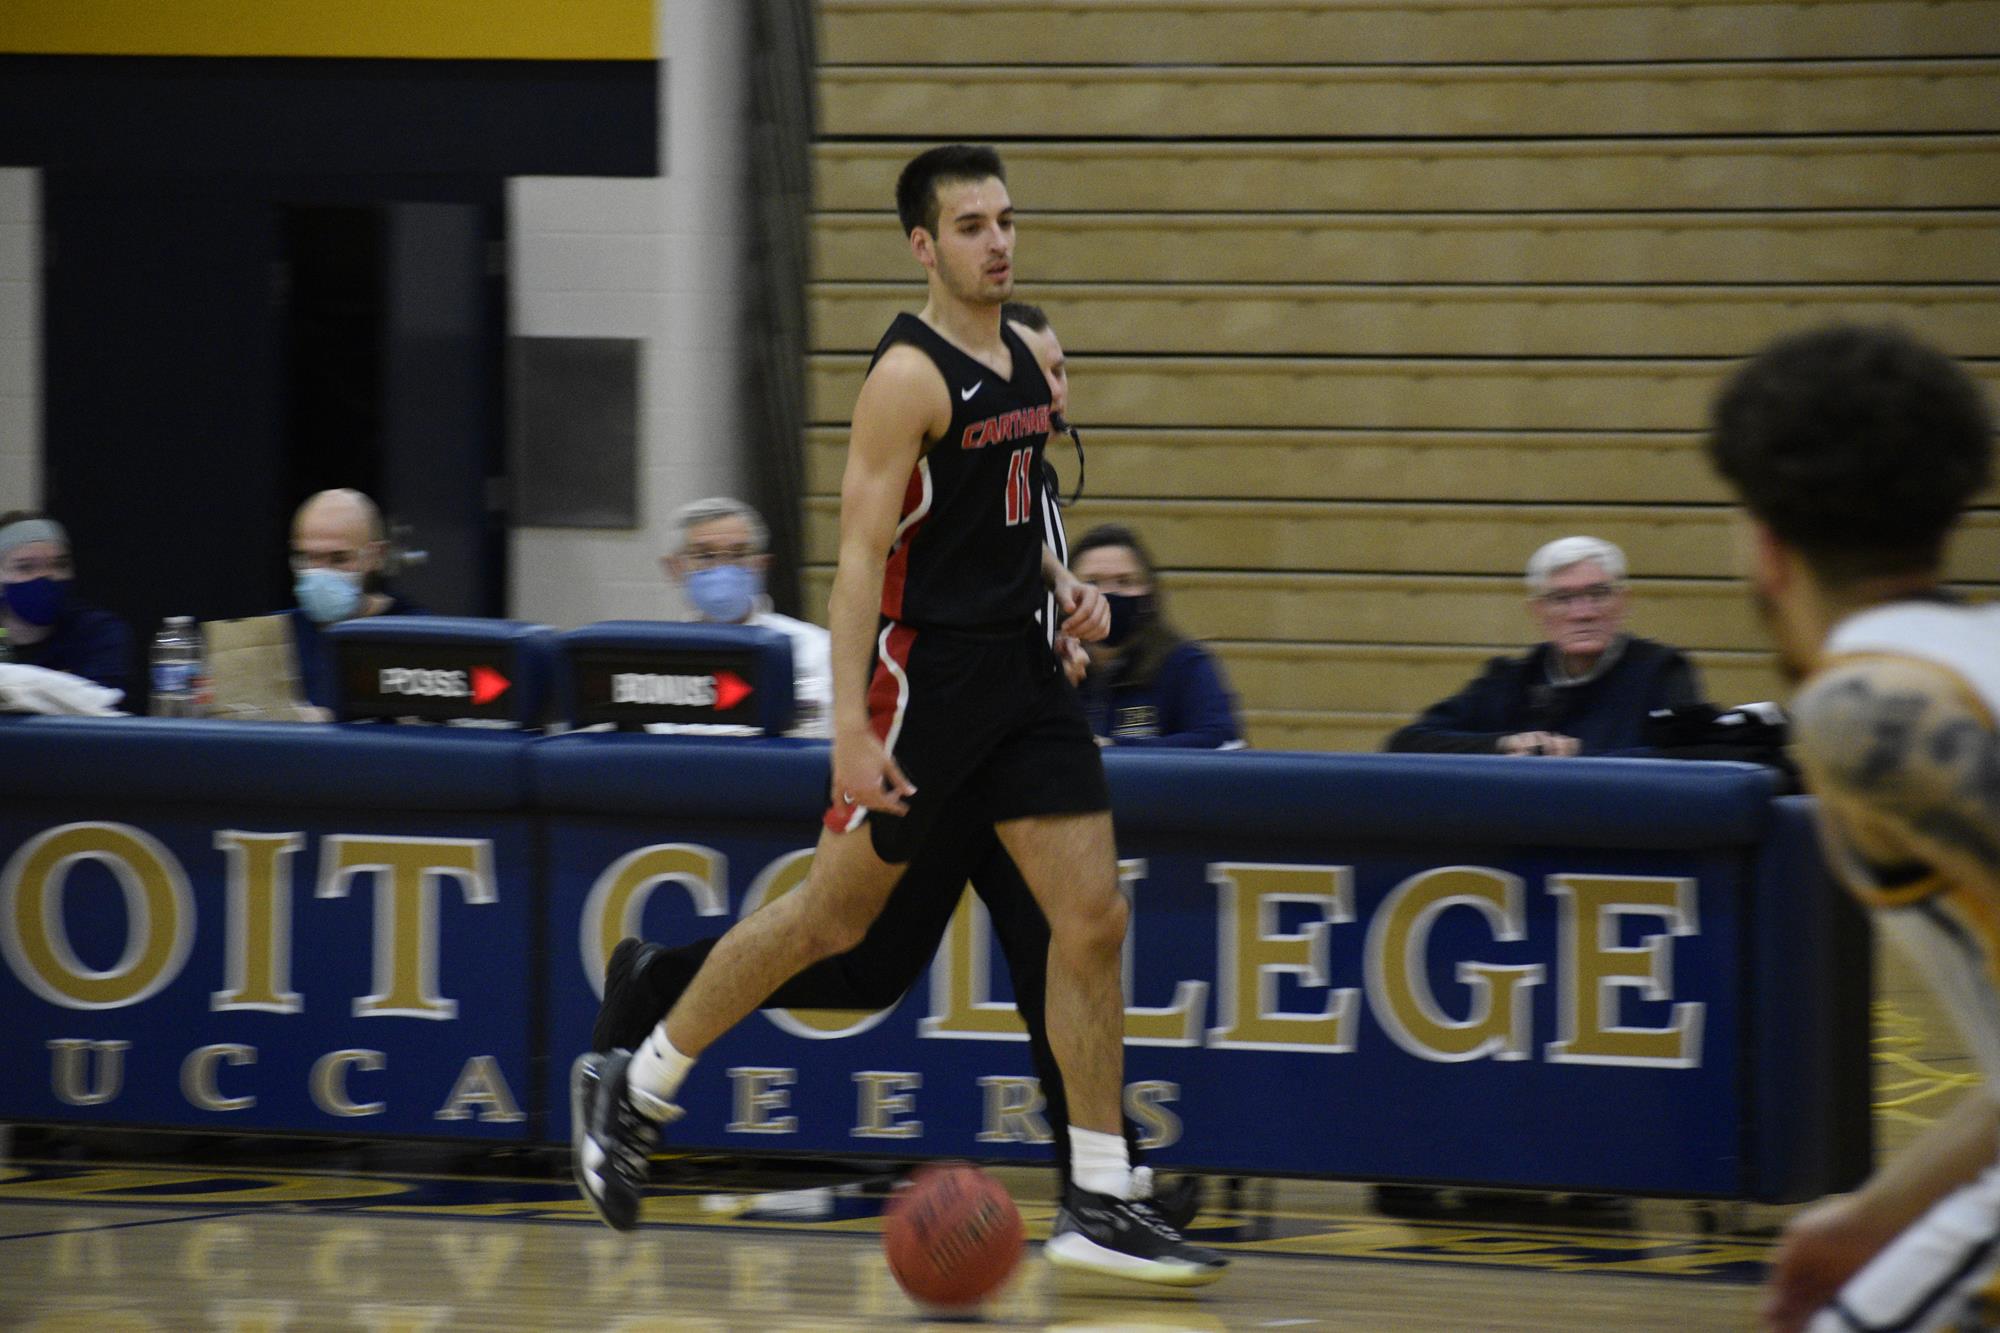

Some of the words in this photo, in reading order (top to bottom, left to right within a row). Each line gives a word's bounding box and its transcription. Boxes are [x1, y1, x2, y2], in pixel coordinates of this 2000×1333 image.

[962, 404, 1050, 449] CARTHAG
[1005, 446, 1033, 526] 11
[611, 672, 717, 706] BONUS
[0, 820, 499, 1021] OIT
